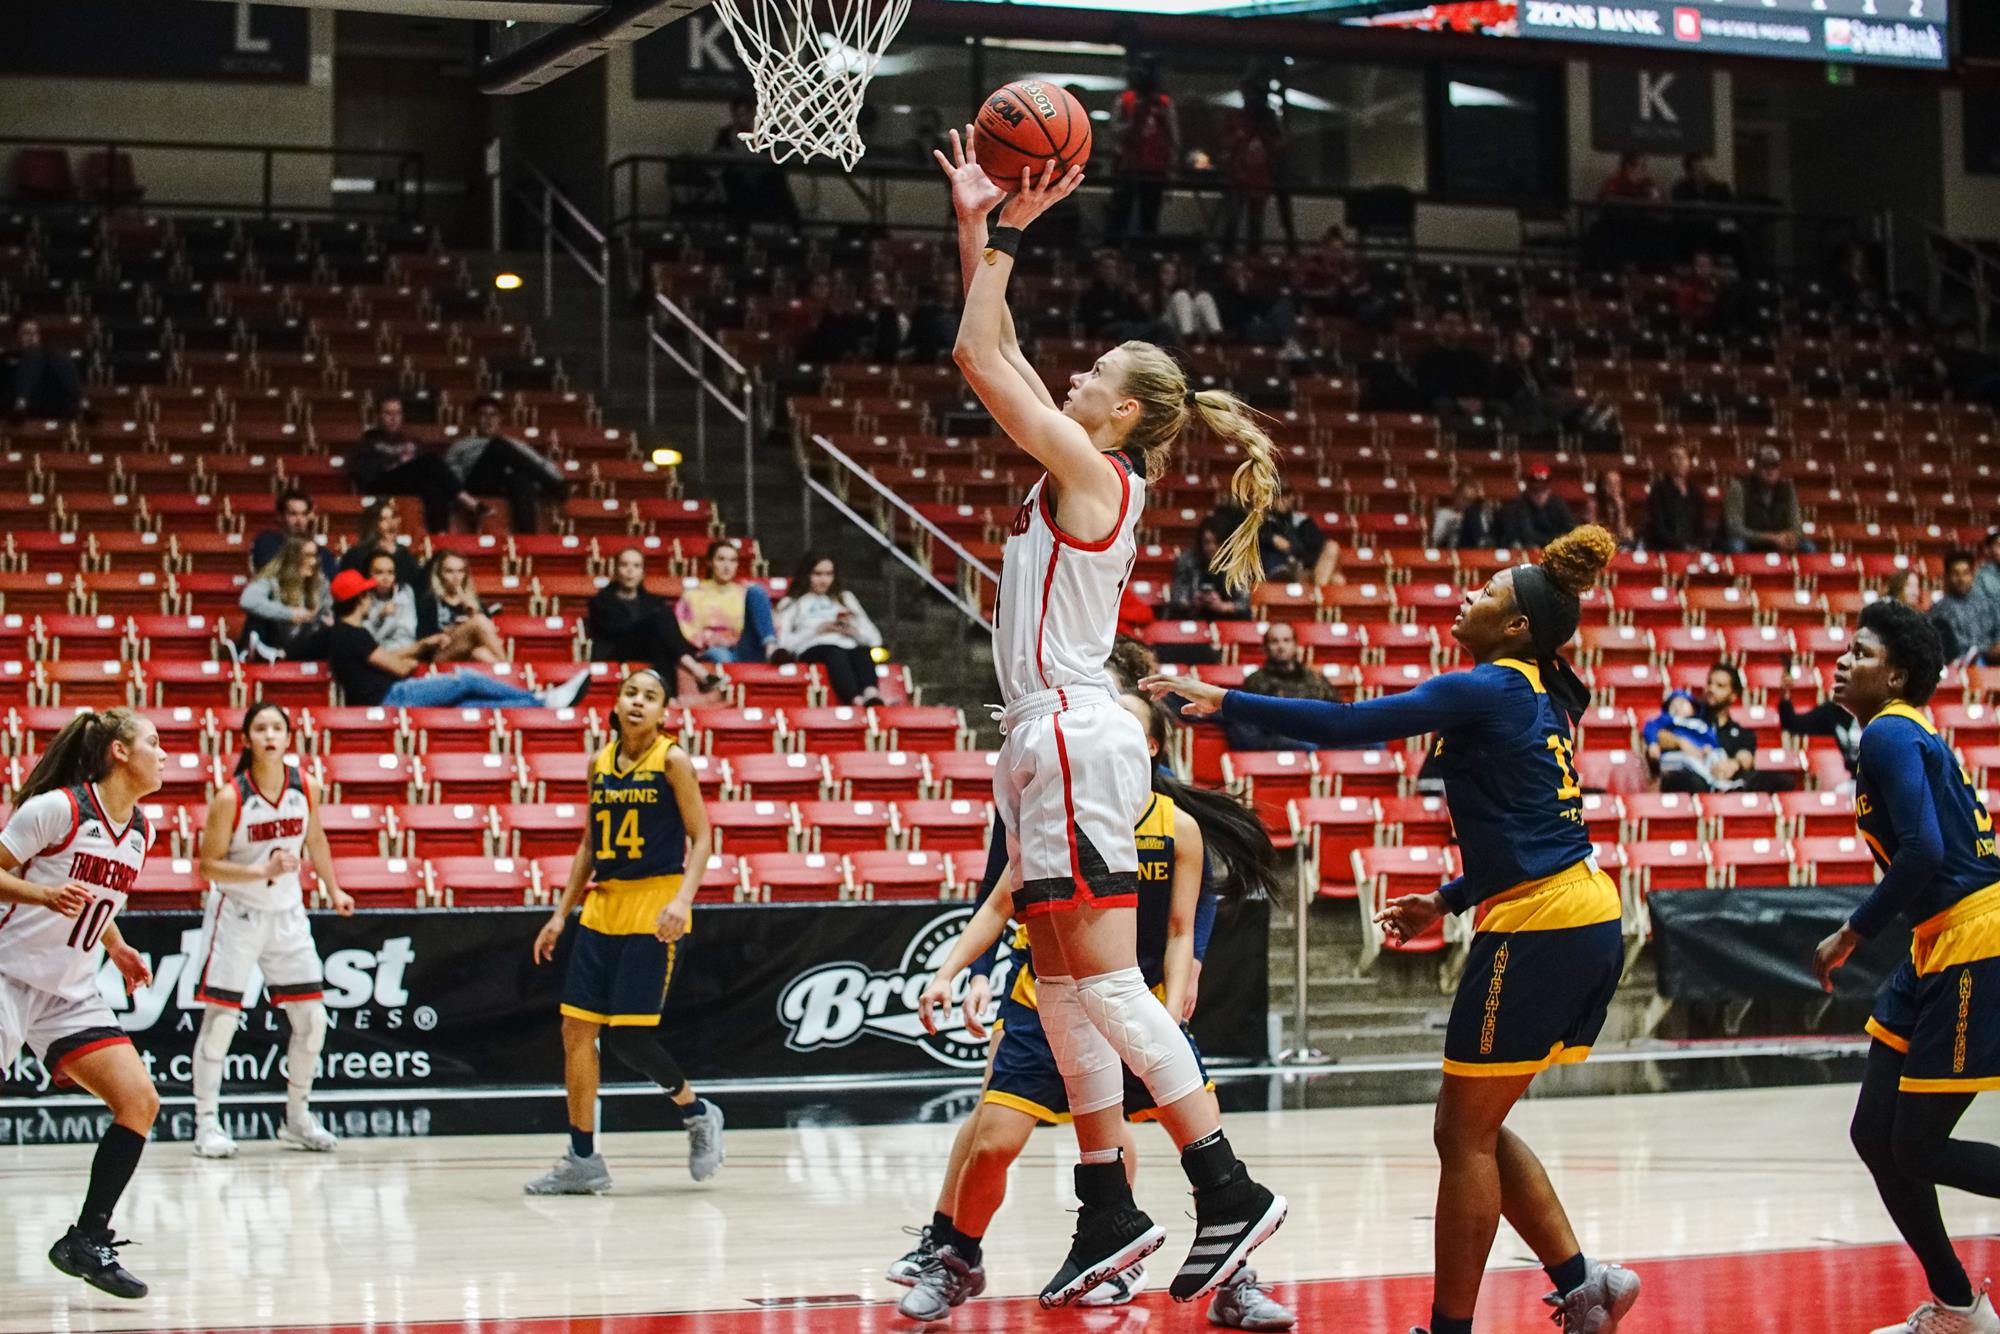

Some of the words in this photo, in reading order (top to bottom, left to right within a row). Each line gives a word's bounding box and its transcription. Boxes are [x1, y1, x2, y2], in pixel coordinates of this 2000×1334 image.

[236, 3, 270, 52] L
[688, 15, 734, 70] K
[1525, 1, 1596, 30] ZIONS
[1598, 6, 1665, 35] BANK
[1639, 70, 1678, 121] K
[605, 788, 658, 804] IRVINE
[595, 808, 645, 860] 14
[66, 893, 115, 952] 10
[1480, 941, 1509, 1055] ANTEATERS
